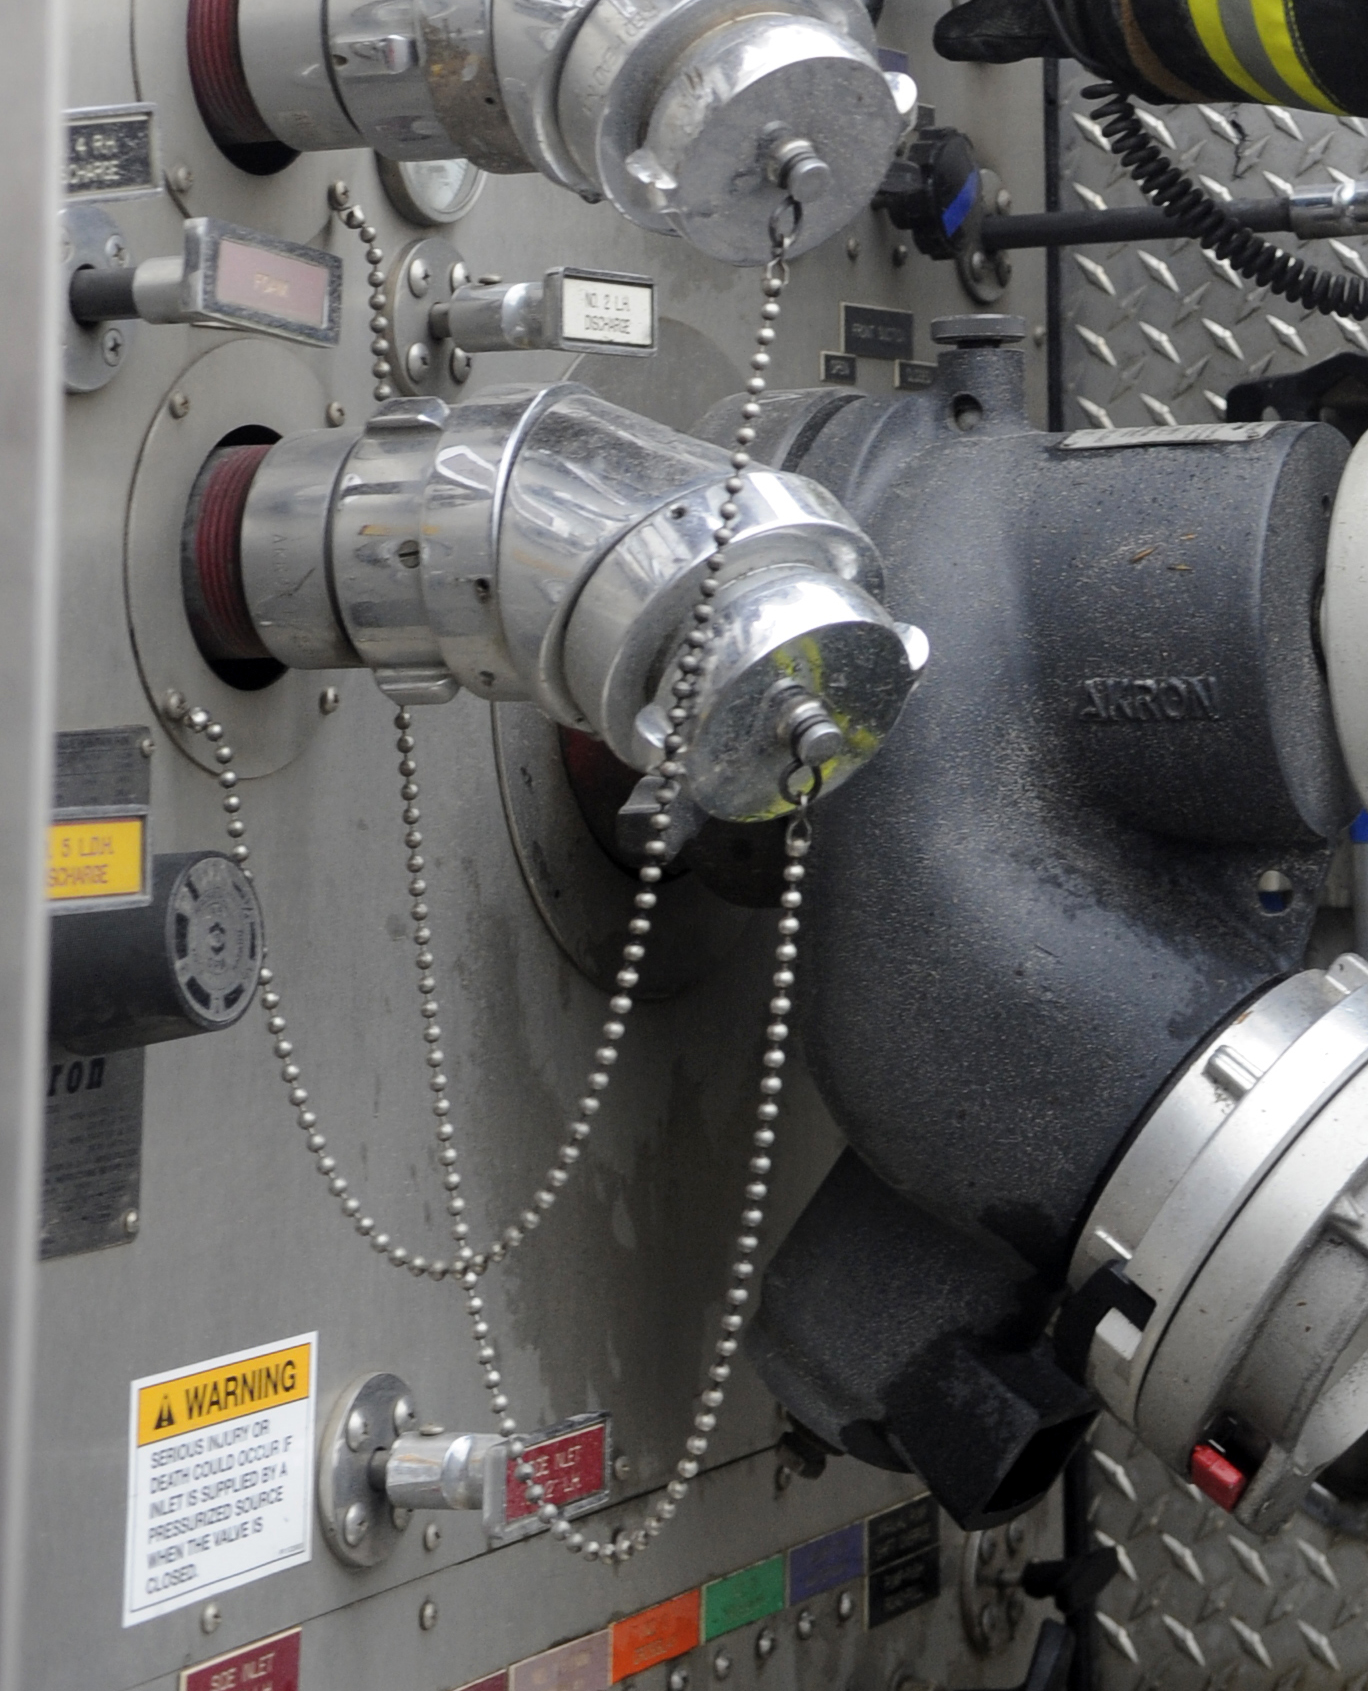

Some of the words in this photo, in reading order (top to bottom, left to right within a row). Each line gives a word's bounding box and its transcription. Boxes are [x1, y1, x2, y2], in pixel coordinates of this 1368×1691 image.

[583, 313, 631, 336] DISCHARGE
[1078, 675, 1221, 723] AKRON
[47, 1056, 105, 1098] ron
[185, 1359, 297, 1421] WARNING
[150, 1438, 205, 1469] SERIOUS
[207, 1424, 251, 1452] INJURY
[252, 1418, 271, 1439] OR
[150, 1467, 191, 1495] DEATH
[192, 1453, 235, 1481] COULD
[237, 1439, 280, 1467] OCCUR
[282, 1434, 294, 1453] IF
[554, 1444, 583, 1471] INLET
[147, 1502, 233, 1545] PRESSURIZED
[234, 1485, 285, 1517] SOURCE
[148, 1493, 184, 1521] INLET
[186, 1489, 199, 1507] IS
[200, 1470, 259, 1503] SUPPLIED
[261, 1463, 278, 1484] BY
[279, 1461, 289, 1478] A
[146, 1542, 185, 1570] WHEN
[187, 1532, 212, 1557] THE
[212, 1520, 250, 1548] VALVE
[251, 1515, 264, 1535] IS
[211, 1667, 238, 1691] SIDE
[242, 1652, 276, 1683] INLET
